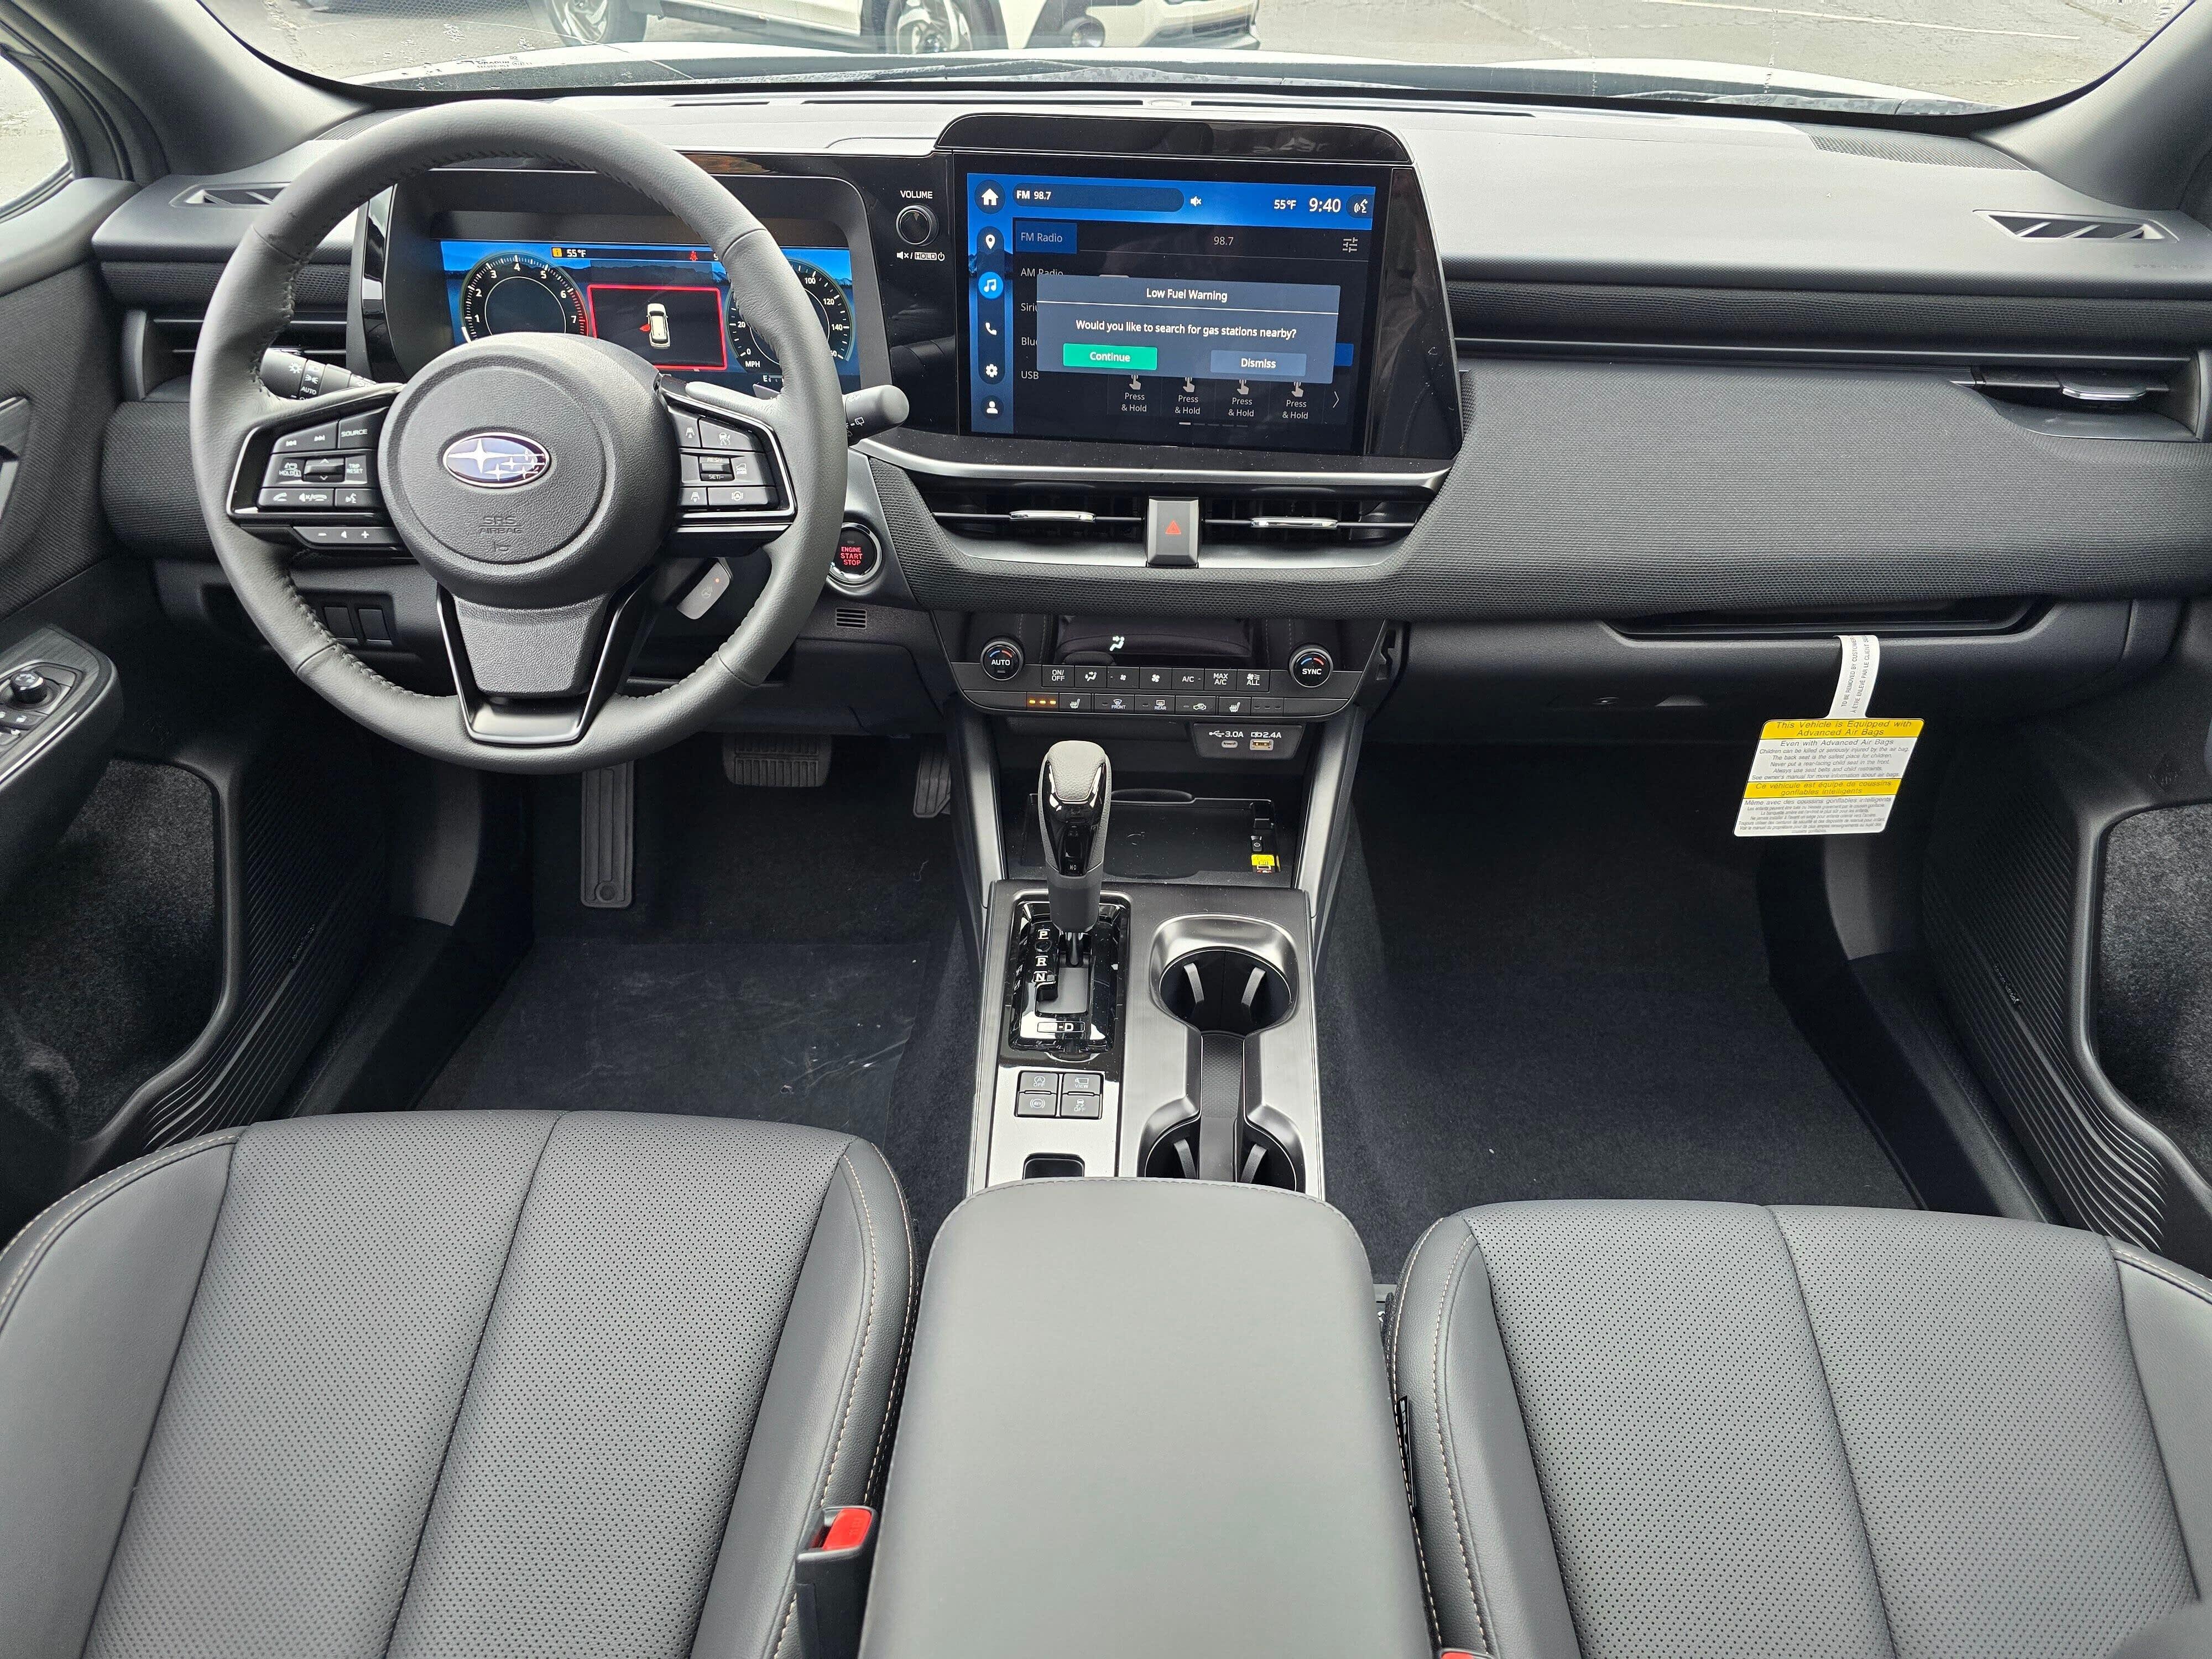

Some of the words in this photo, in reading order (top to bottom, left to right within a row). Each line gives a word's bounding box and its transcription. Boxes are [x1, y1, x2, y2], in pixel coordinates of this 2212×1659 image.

[900, 190, 933, 199] VOLUME
[1016, 190, 1030, 200] FM
[1034, 191, 1052, 200] 98.7
[1274, 199, 1297, 210] 55°F
[1309, 198, 1341, 213] 9:40
[1021, 232, 1034, 242] FM
[1037, 232, 1063, 242] Radio
[1214, 236, 1234, 246] 98.7
[567, 249, 586, 258] 55°F
[514, 263, 521, 272] 4
[1021, 268, 1035, 276] AM
[490, 270, 497, 279] 3
[540, 270, 547, 279] 5
[475, 288, 482, 297] 2
[560, 290, 567, 299] 6
[1146, 288, 1166, 298] Low
[1167, 289, 1186, 299] Fuel
[1188, 289, 1228, 303] Warning
[474, 314, 480, 323] 1
[571, 315, 577, 324] 7
[1076, 320, 1105, 330] Would
[1107, 322, 1124, 333] you
[1126, 321, 1141, 332] like
[1144, 323, 1154, 332] to
[1155, 324, 1185, 334] search
[1188, 324, 1201, 335] for
[1203, 326, 1219, 337] gas
[1221, 326, 1258, 337] stations
[1260, 328, 1297, 341] nearby?
[1089, 351, 1131, 362] Continue
[1241, 358, 1276, 369] Dismiss
[1021, 371, 1039, 379] USB
[300, 386, 317, 395] AUTO
[1125, 392, 1145, 400] Press
[1232, 397, 1253, 405] Press
[1286, 399, 1307, 408] Press
[341, 429, 368, 437] SOURCE
[483, 517, 517, 525] SRS
[1846, 671, 1855, 693] REMOVED
[1039, 930, 1049, 939] P
[1036, 957, 1047, 967] R
[1035, 973, 1046, 982] N
